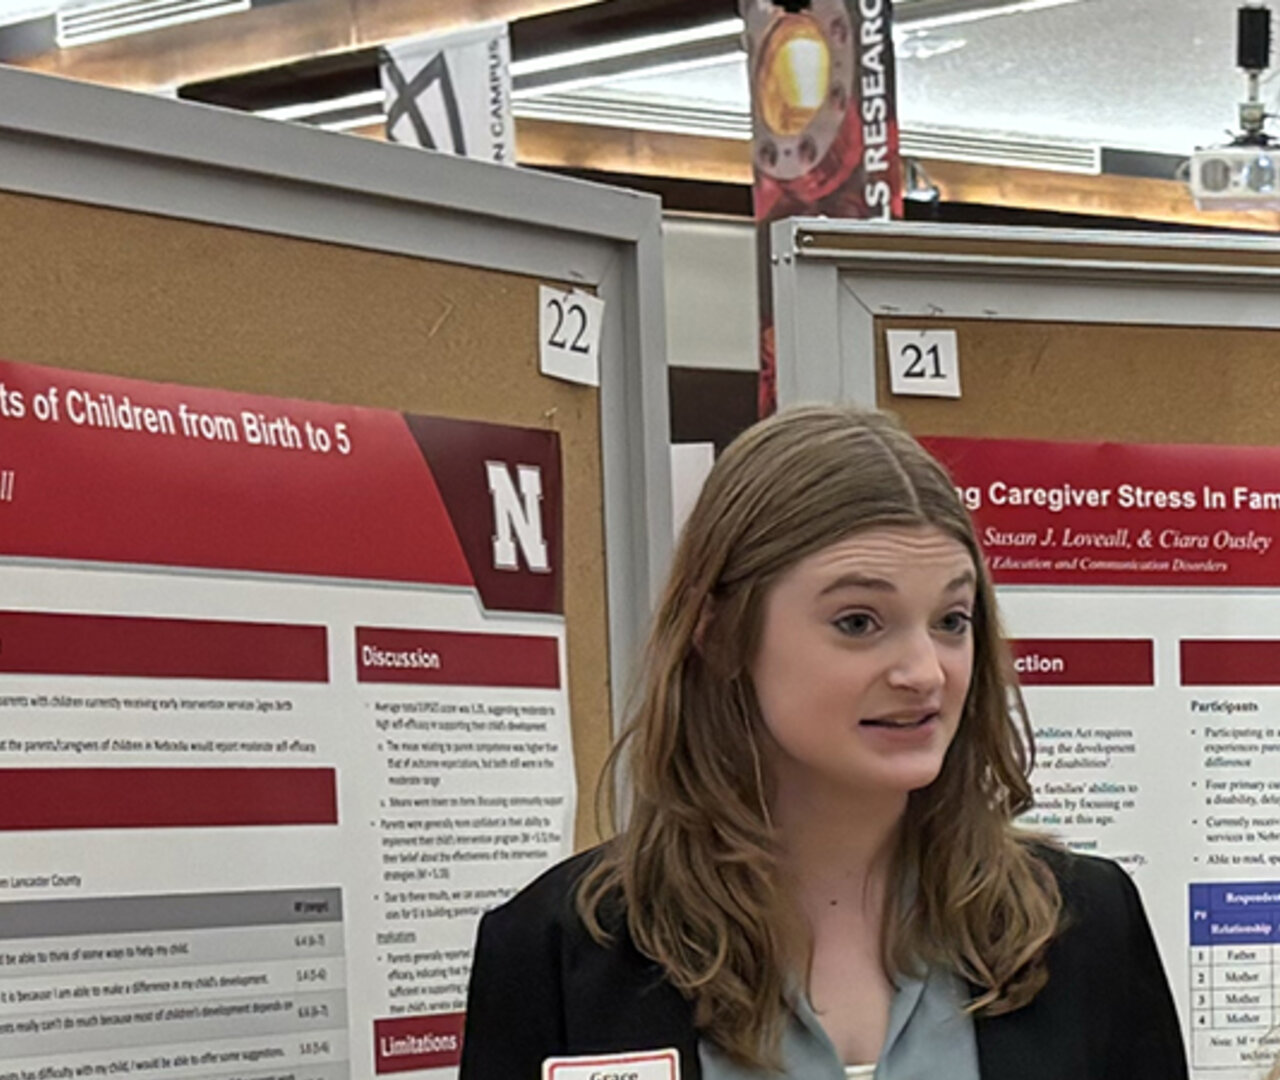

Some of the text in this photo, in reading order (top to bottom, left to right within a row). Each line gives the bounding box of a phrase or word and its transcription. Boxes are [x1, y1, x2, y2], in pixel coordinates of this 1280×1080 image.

[488, 40, 504, 137] CAMPUS
[546, 298, 590, 354] 22
[901, 344, 946, 379] 21
[34, 387, 58, 420] of
[66, 390, 175, 434] Children
[179, 404, 238, 441] from
[241, 412, 302, 448] Birth
[305, 421, 330, 452] to
[335, 423, 350, 454] 5
[989, 482, 1111, 511] Caregiver
[1118, 485, 1196, 508] Stress
[1204, 487, 1226, 508] In
[485, 461, 551, 573] N
[984, 527, 1271, 553] Susan J. Loveall, & Ciara Ousley
[993, 557, 1227, 571] Education and Communication Disorders
[362, 646, 440, 669] Discussion
[1191, 701, 1258, 713] Participants
[380, 1033, 457, 1058] Limitations
